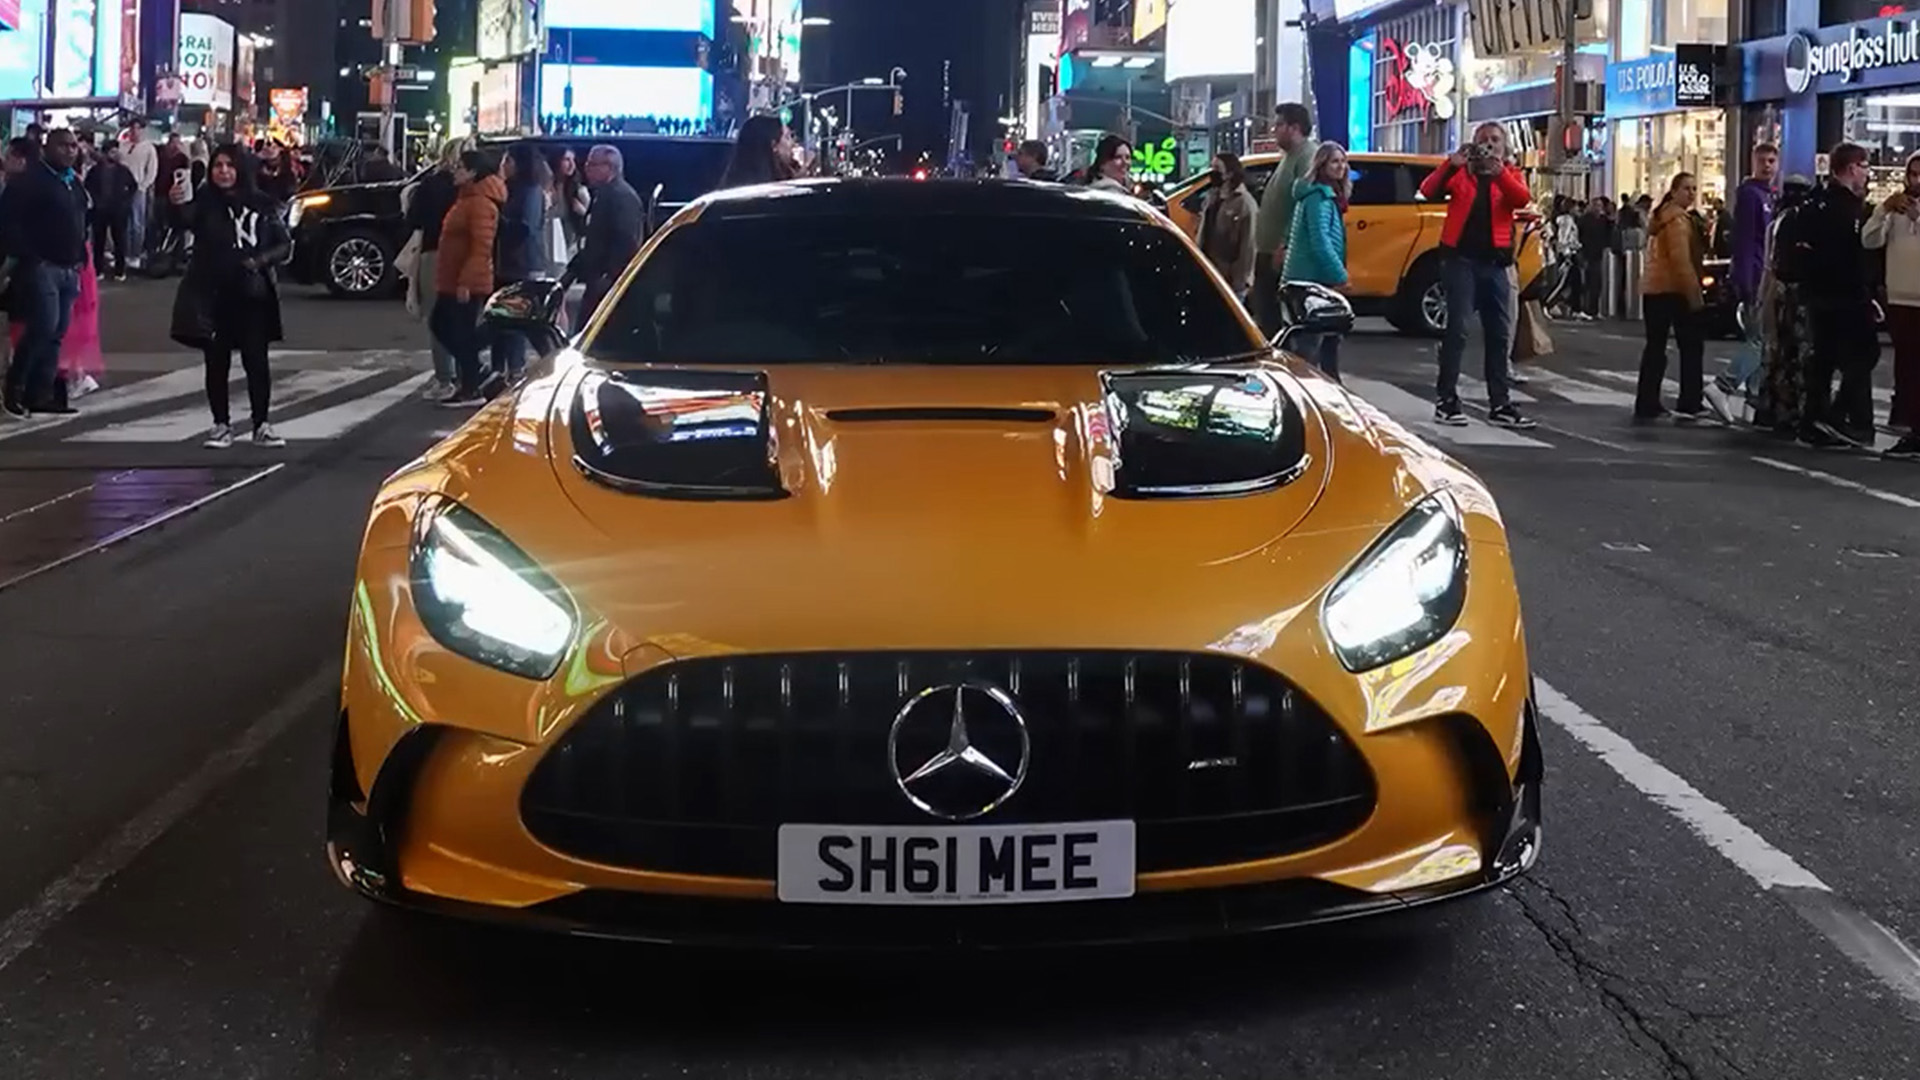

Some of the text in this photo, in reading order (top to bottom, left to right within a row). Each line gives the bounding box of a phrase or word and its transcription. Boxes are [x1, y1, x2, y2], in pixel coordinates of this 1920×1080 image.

[1809, 19, 1920, 83] sunglass hut
[1636, 62, 1666, 90] POLO
[1678, 73, 1710, 85] POLO
[818, 832, 1098, 893] SH61 MEE
